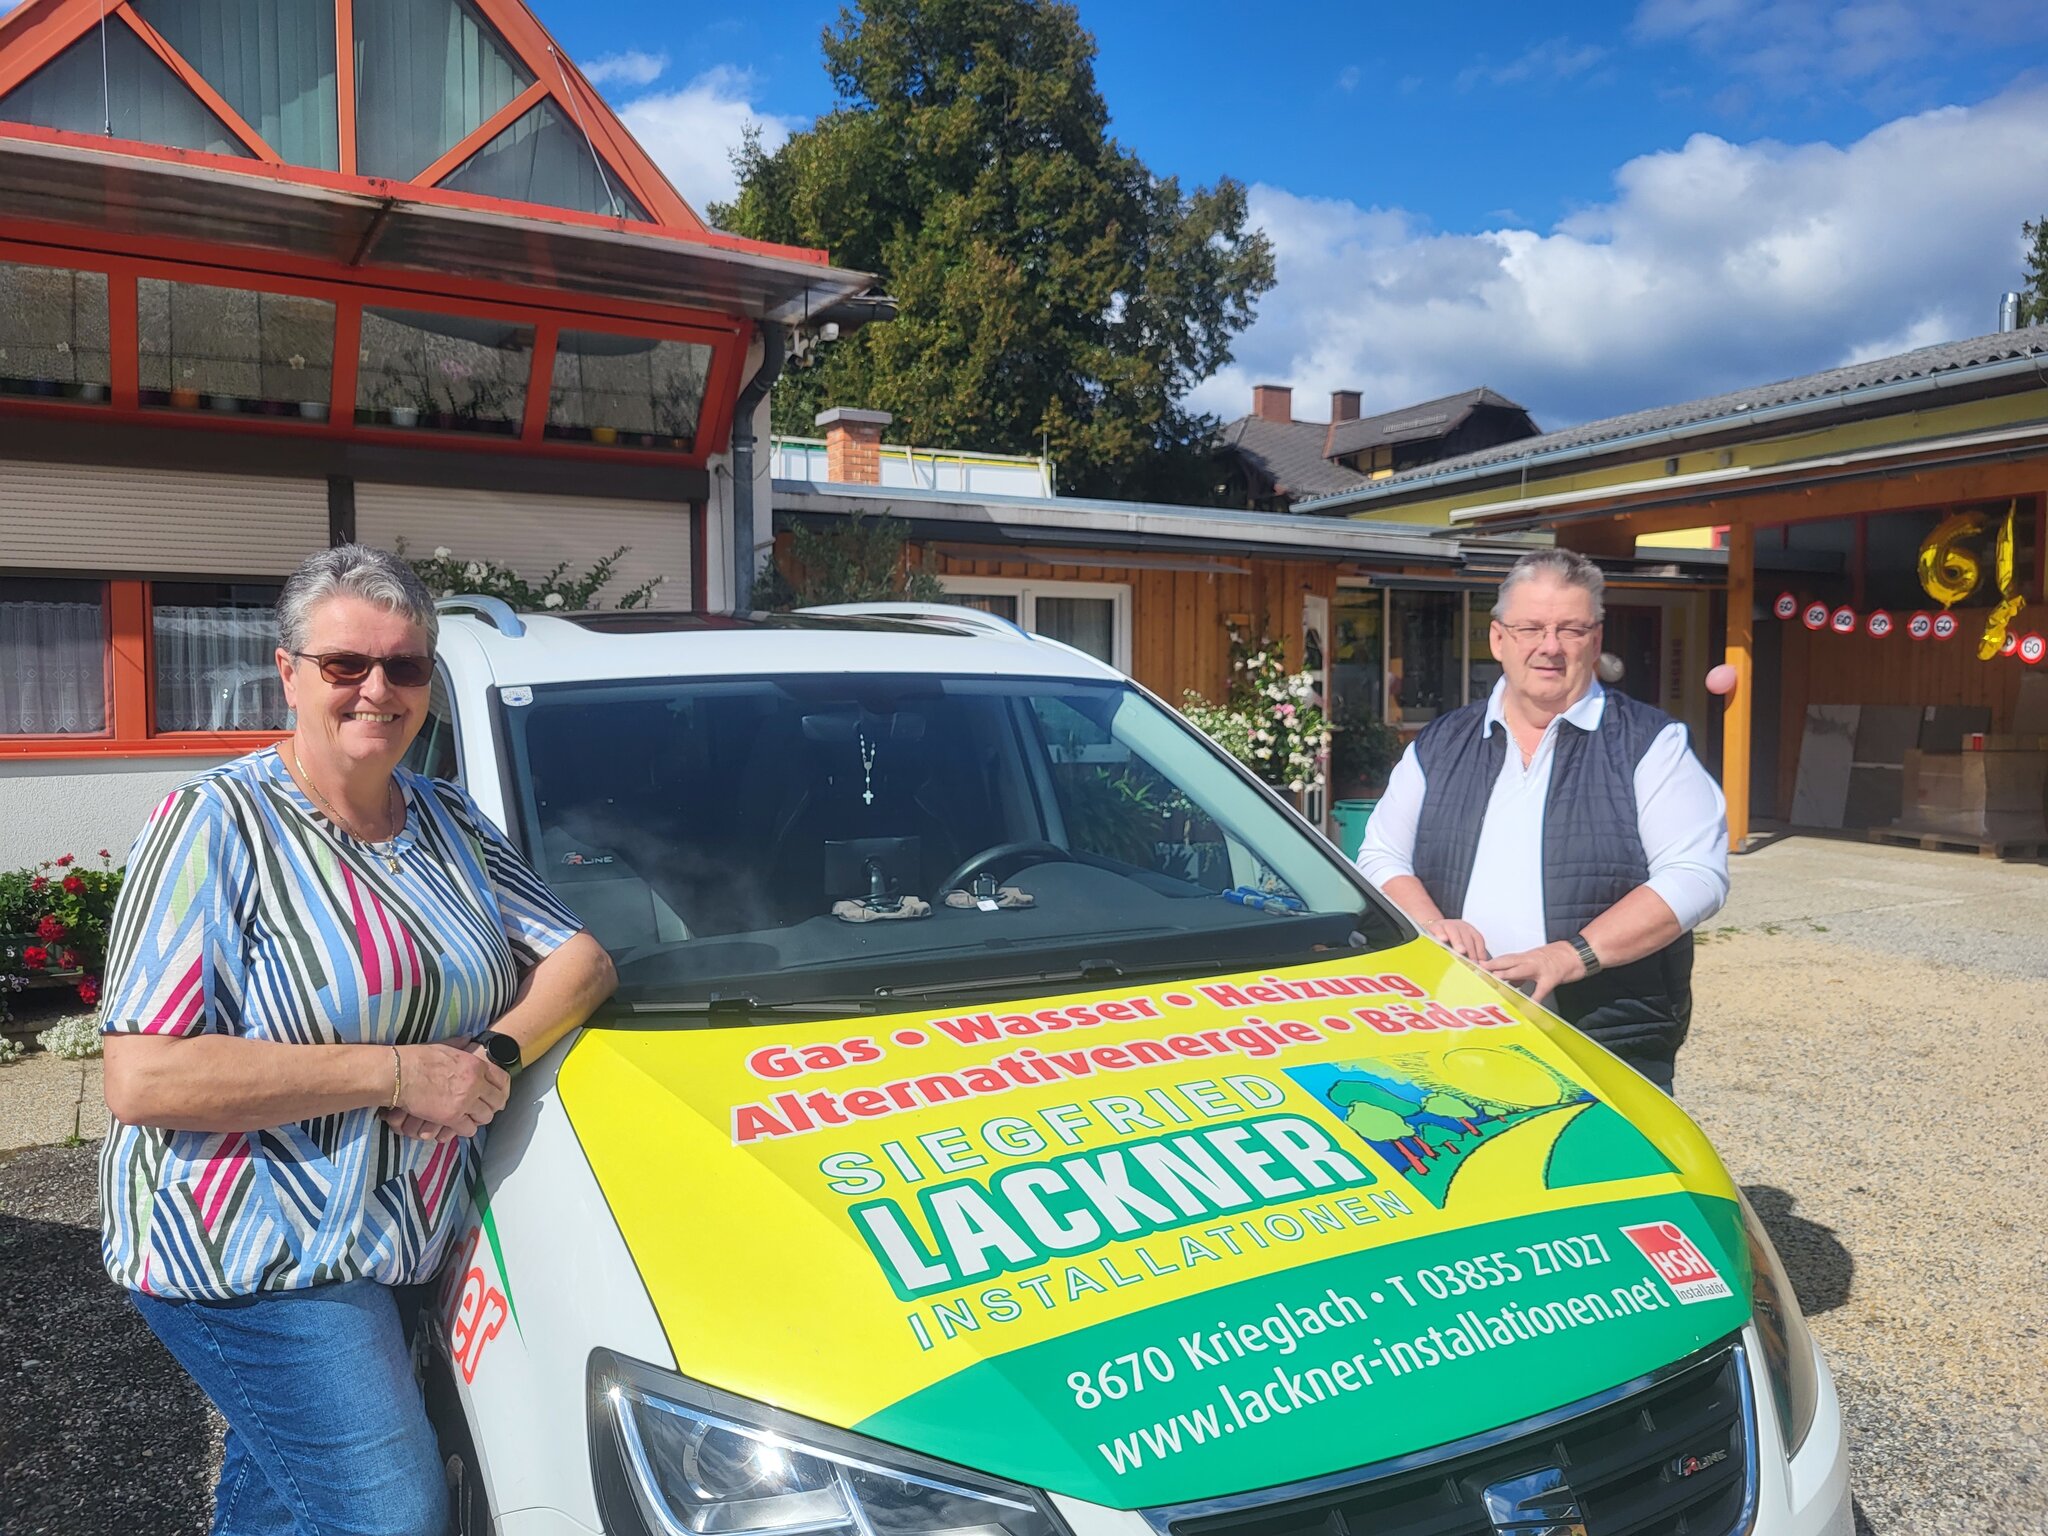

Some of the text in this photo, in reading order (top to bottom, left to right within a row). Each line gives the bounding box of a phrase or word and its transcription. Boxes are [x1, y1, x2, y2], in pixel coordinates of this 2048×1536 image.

[1809, 609, 1825, 622] 60
[1836, 614, 1852, 626] 60
[2023, 640, 2040, 654] 60
[734, 1002, 1516, 1143] Alternativenergie Bäder
[748, 974, 1426, 1081] Gas Wasser Heizung
[819, 1074, 1286, 1196] SIEGFRIED
[856, 1116, 1371, 1295] LACKNER
[1650, 1246, 1709, 1280] HSH
[907, 1190, 1414, 1351] INSTALLATIONEN
[1066, 1233, 1611, 1411] 8670 Krieglach T 03855 27027
[1098, 1275, 1671, 1476] www.lackner-installationen.net
